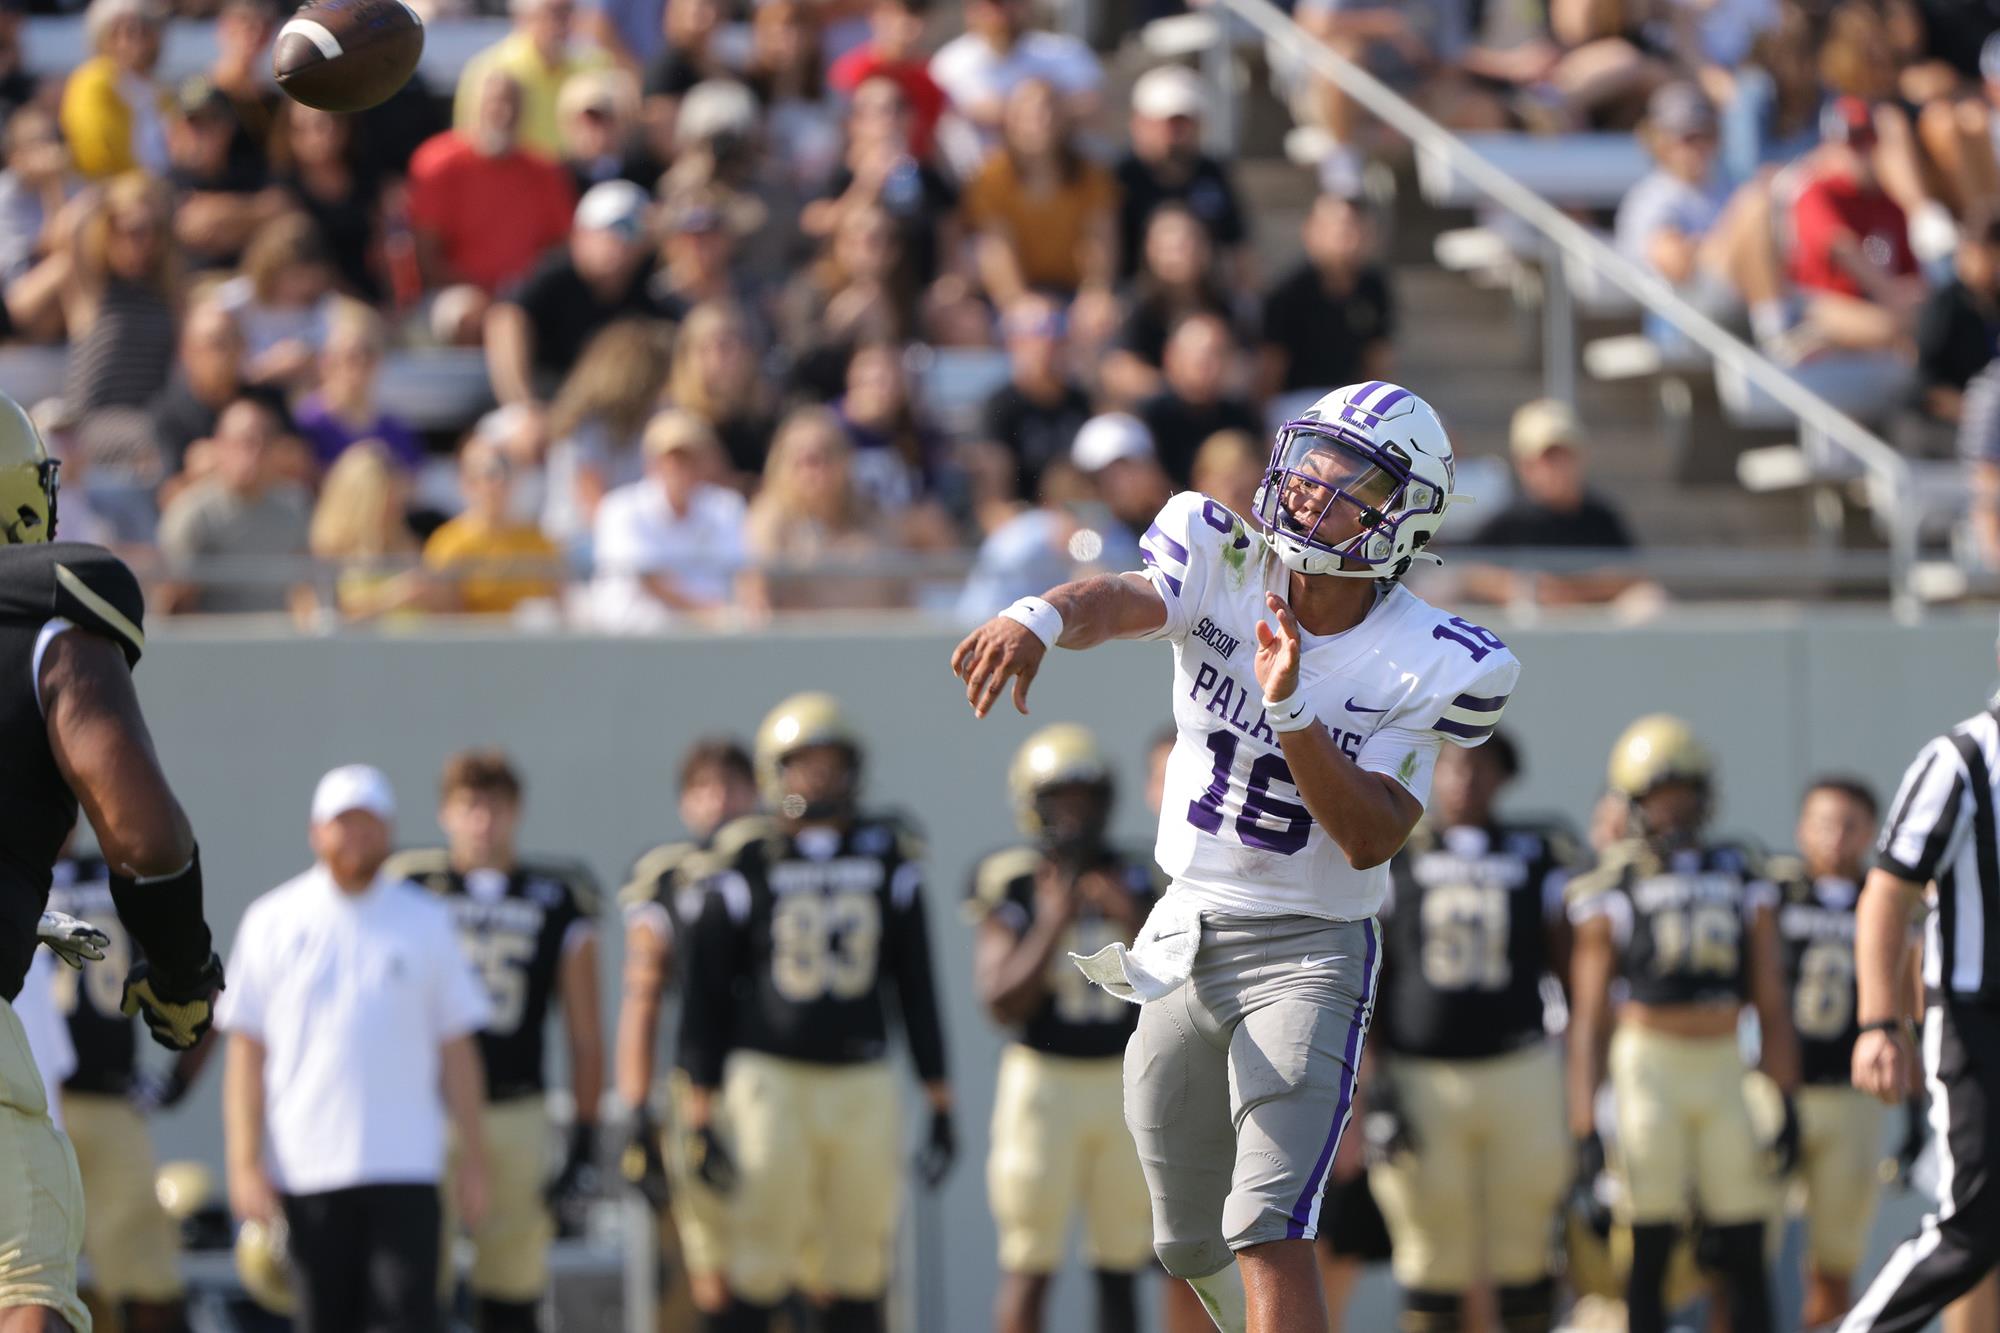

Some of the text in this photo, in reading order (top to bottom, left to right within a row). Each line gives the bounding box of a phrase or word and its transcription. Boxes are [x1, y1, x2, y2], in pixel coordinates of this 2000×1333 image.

[1339, 413, 1368, 430] FURMAN
[1192, 617, 1240, 660] SOCON
[1432, 616, 1506, 663] 16
[1187, 729, 1314, 856] 16
